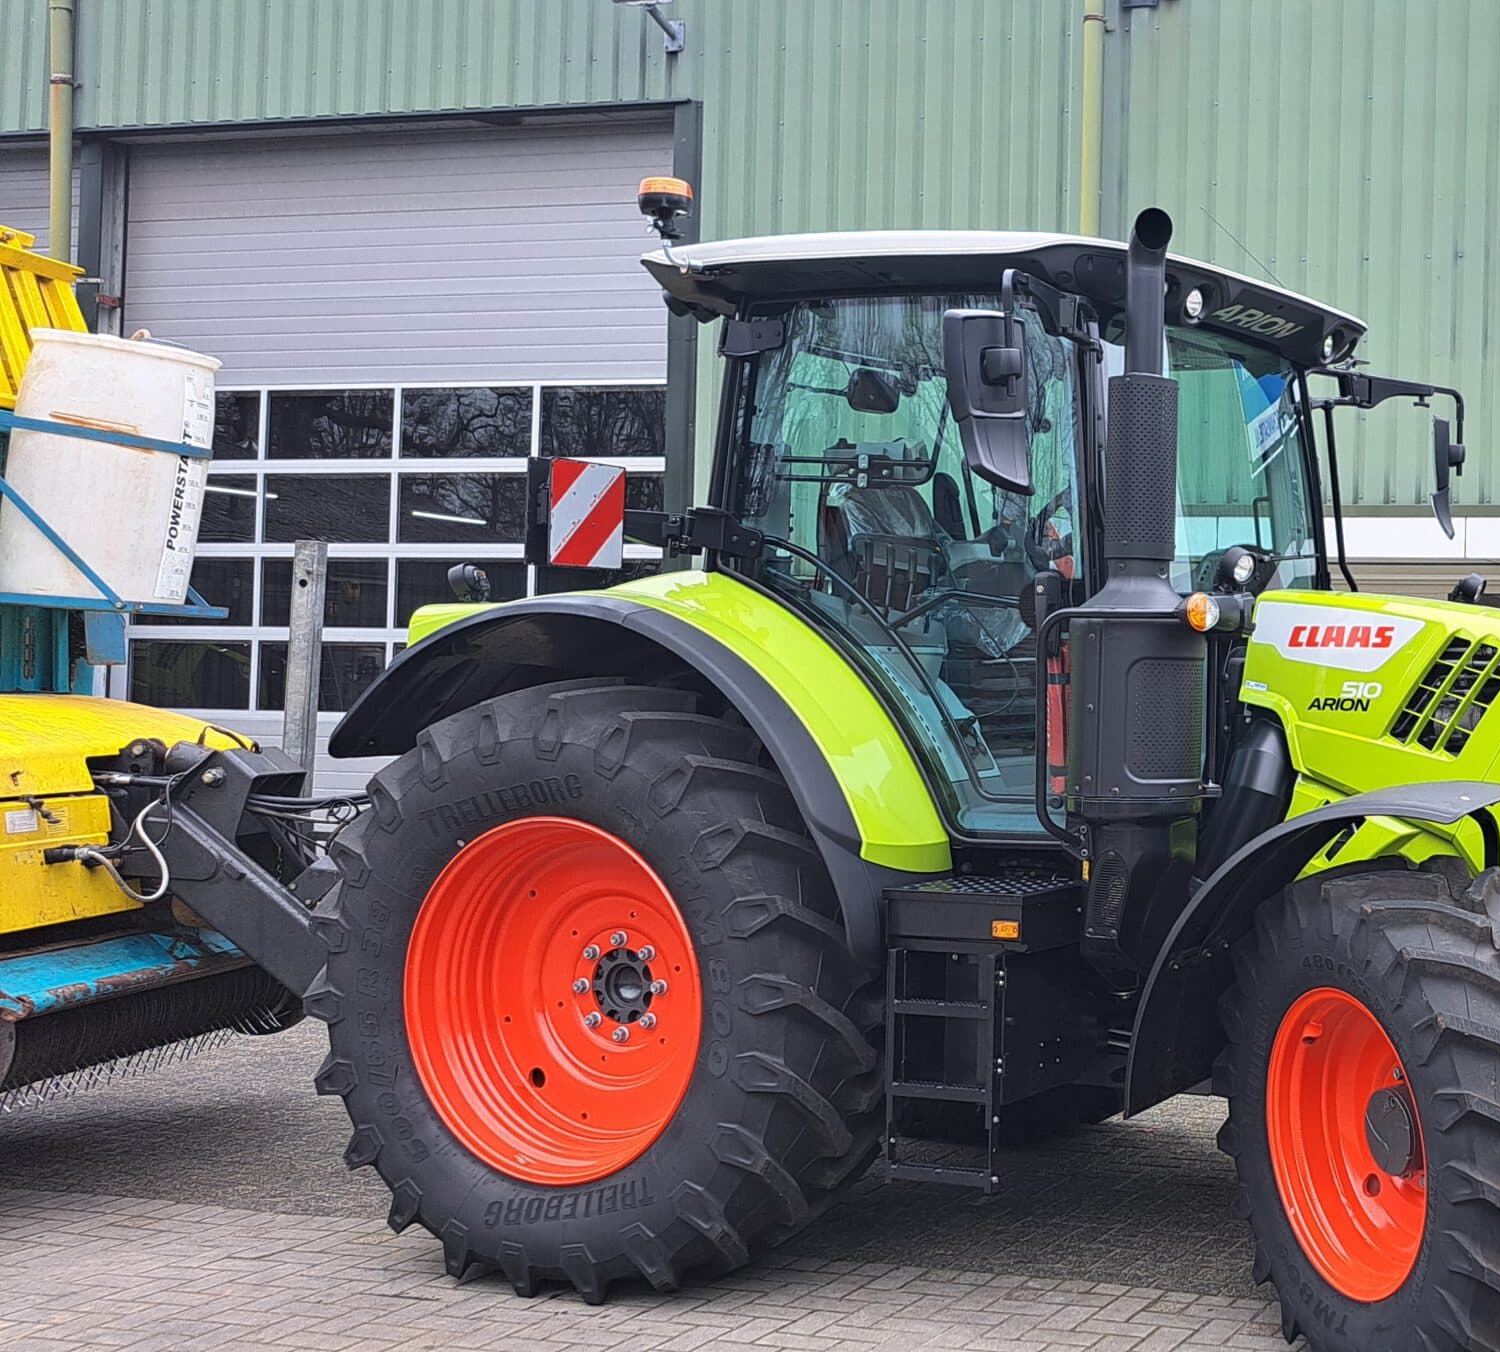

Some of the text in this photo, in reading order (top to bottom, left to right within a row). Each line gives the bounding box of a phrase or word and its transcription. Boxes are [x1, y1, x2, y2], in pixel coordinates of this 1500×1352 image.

[1210, 304, 1305, 338] ARION
[1287, 625, 1396, 649] CLAAS
[1307, 697, 1371, 713] ARION
[1341, 681, 1383, 700] 510
[416, 774, 584, 838] TRELLEBORG
[483, 1176, 657, 1229] TRELLEBORG
